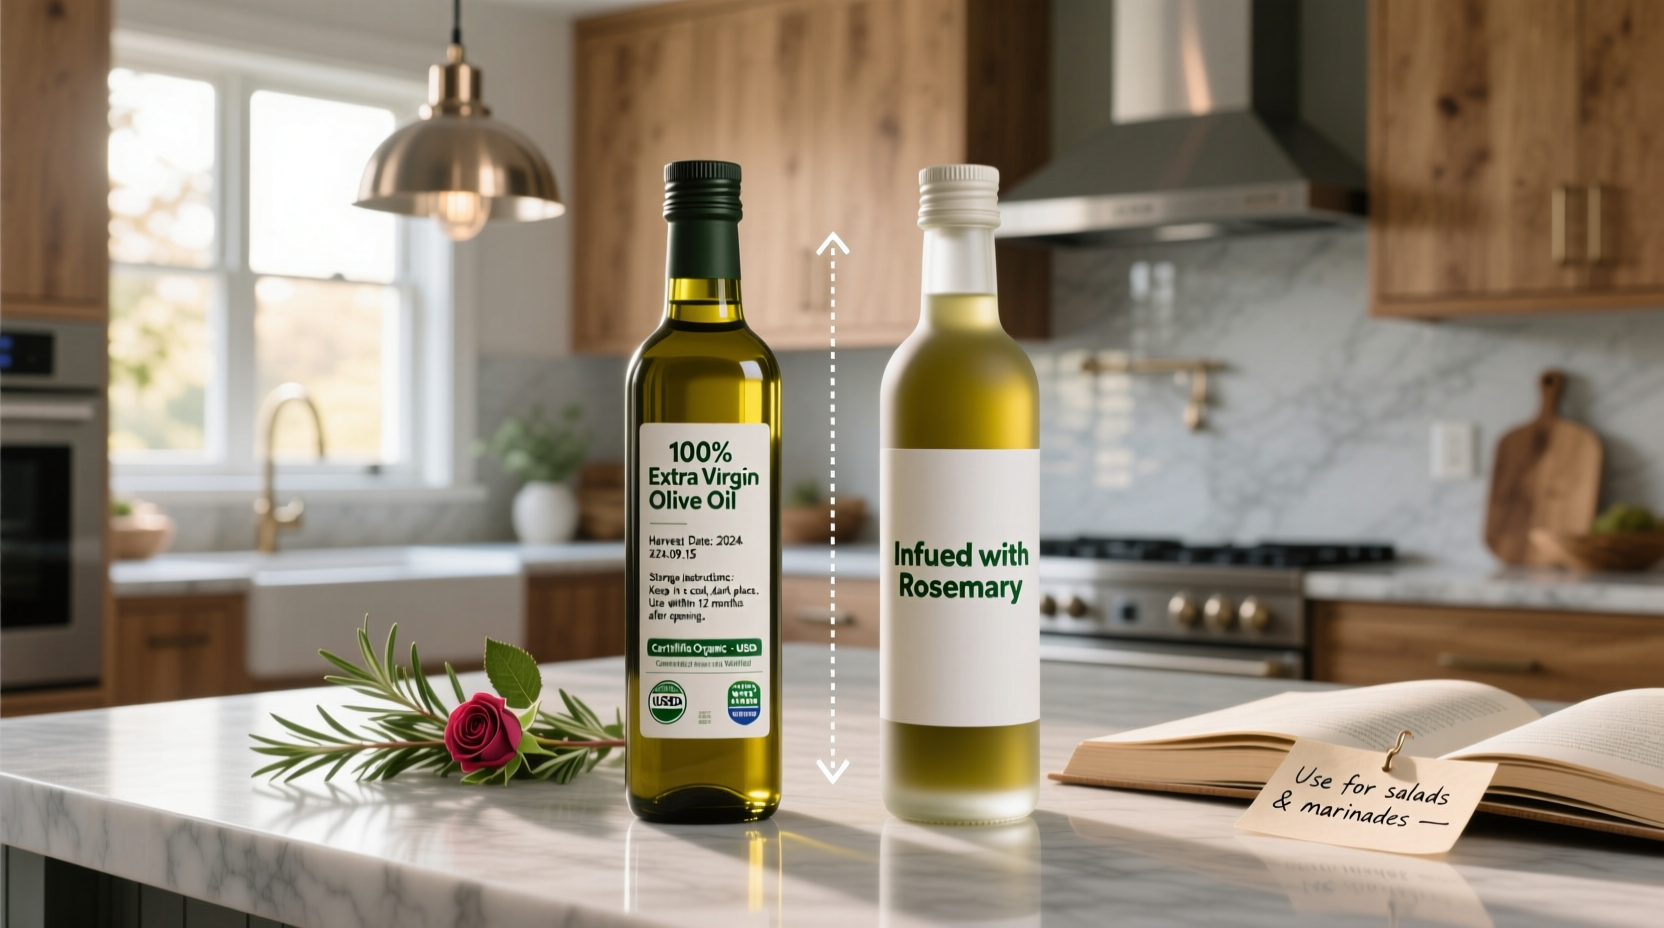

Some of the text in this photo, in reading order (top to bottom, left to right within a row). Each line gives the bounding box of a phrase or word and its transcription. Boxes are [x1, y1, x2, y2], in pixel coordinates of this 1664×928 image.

[669, 441, 732, 463] 100%
[649, 467, 759, 490] Extra Virgin
[649, 490, 736, 510] Olive Oil
[688, 535, 713, 546] Date:
[895, 541, 1029, 567] Infued with
[899, 572, 1023, 605] Rosemary
[699, 599, 709, 608] 12
[1295, 765, 1450, 806] Use for salads
[1272, 790, 1292, 811] &
[1300, 801, 1410, 827] marinades
